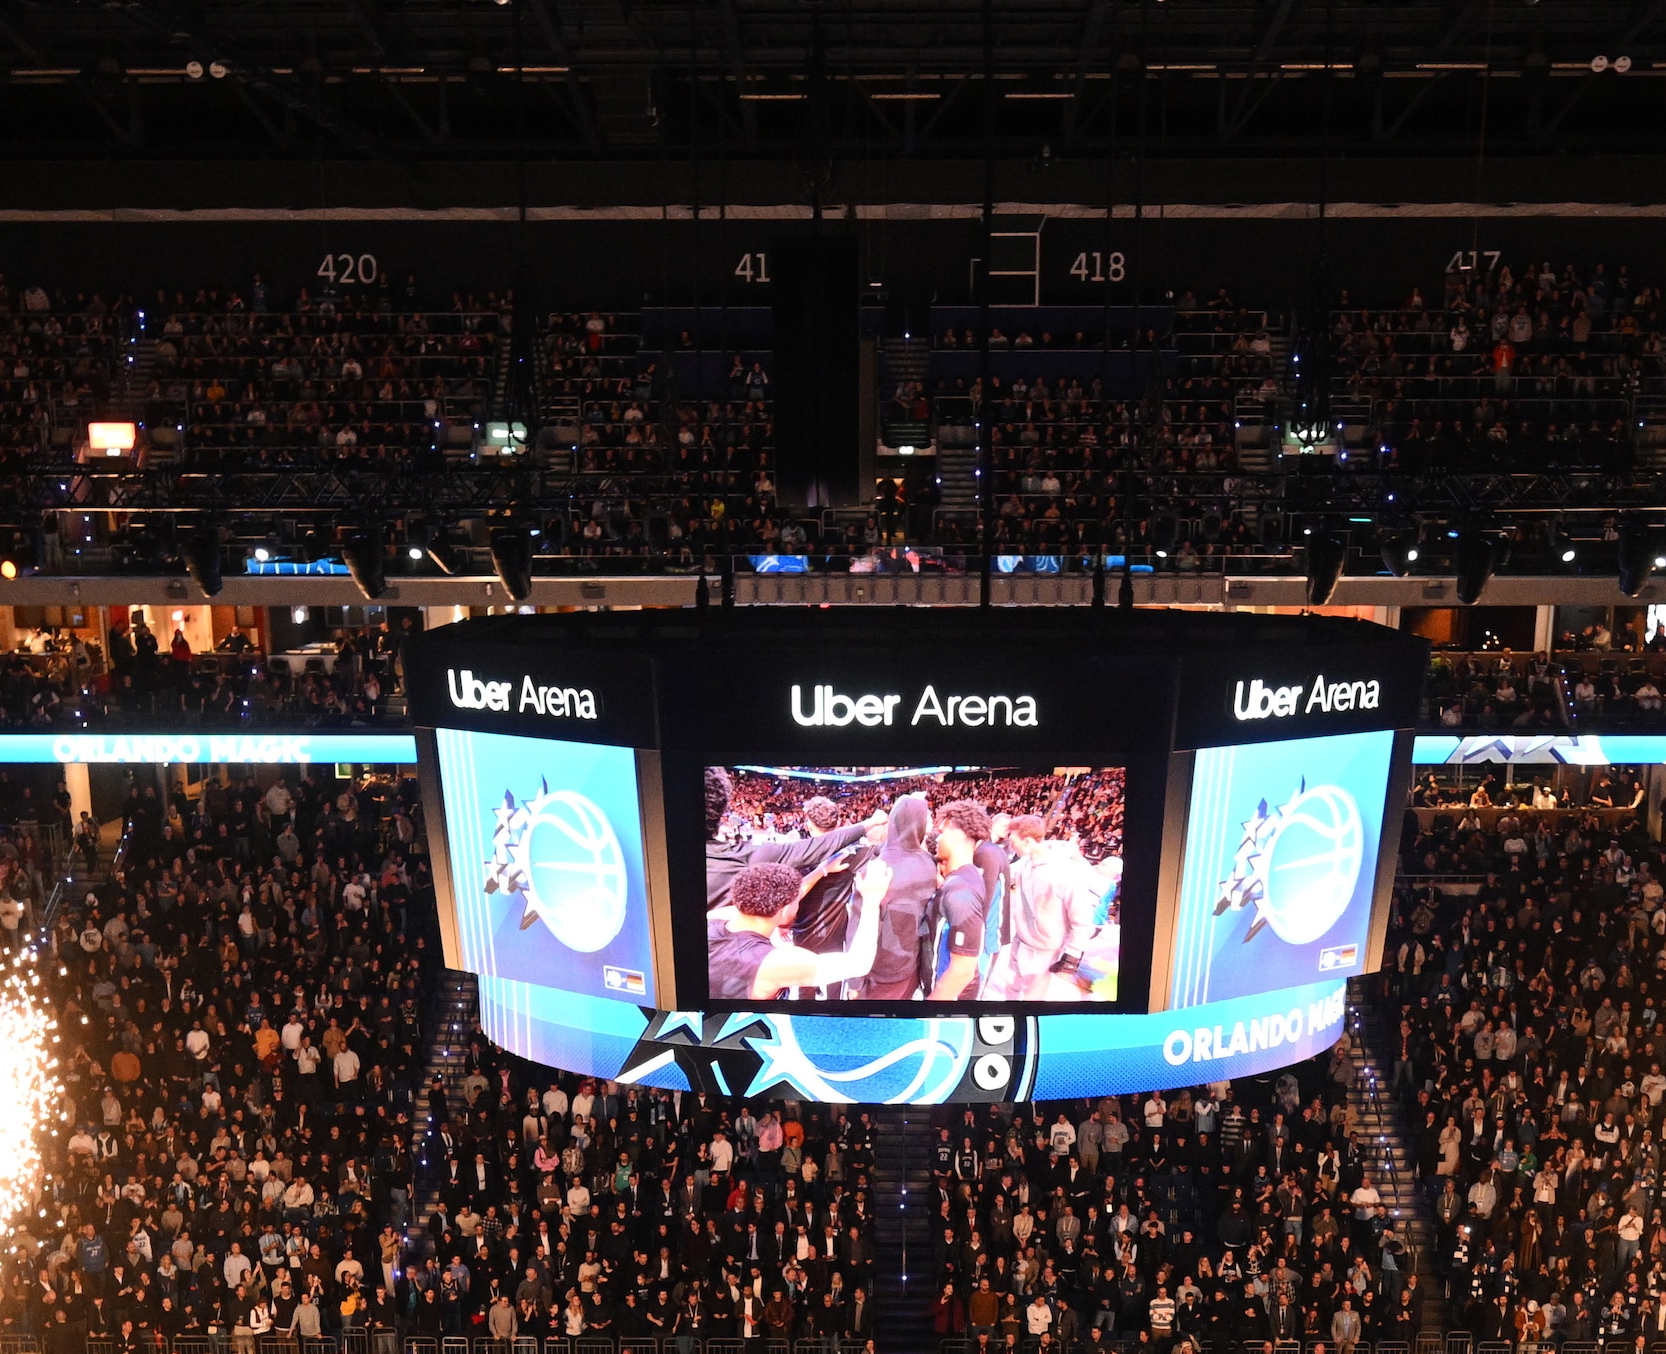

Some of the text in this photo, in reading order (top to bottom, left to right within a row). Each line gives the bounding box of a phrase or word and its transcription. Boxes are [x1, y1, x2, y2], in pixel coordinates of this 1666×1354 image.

[317, 253, 378, 285] 420
[735, 252, 771, 283] 41
[1070, 251, 1125, 283] 418
[447, 668, 597, 720] Uber Arena
[791, 684, 1039, 727] Uber Arena
[1234, 674, 1380, 721] Uber Arena
[52, 735, 311, 764] ORLANDO MAGIC
[1162, 1007, 1304, 1066] ORLANDO
